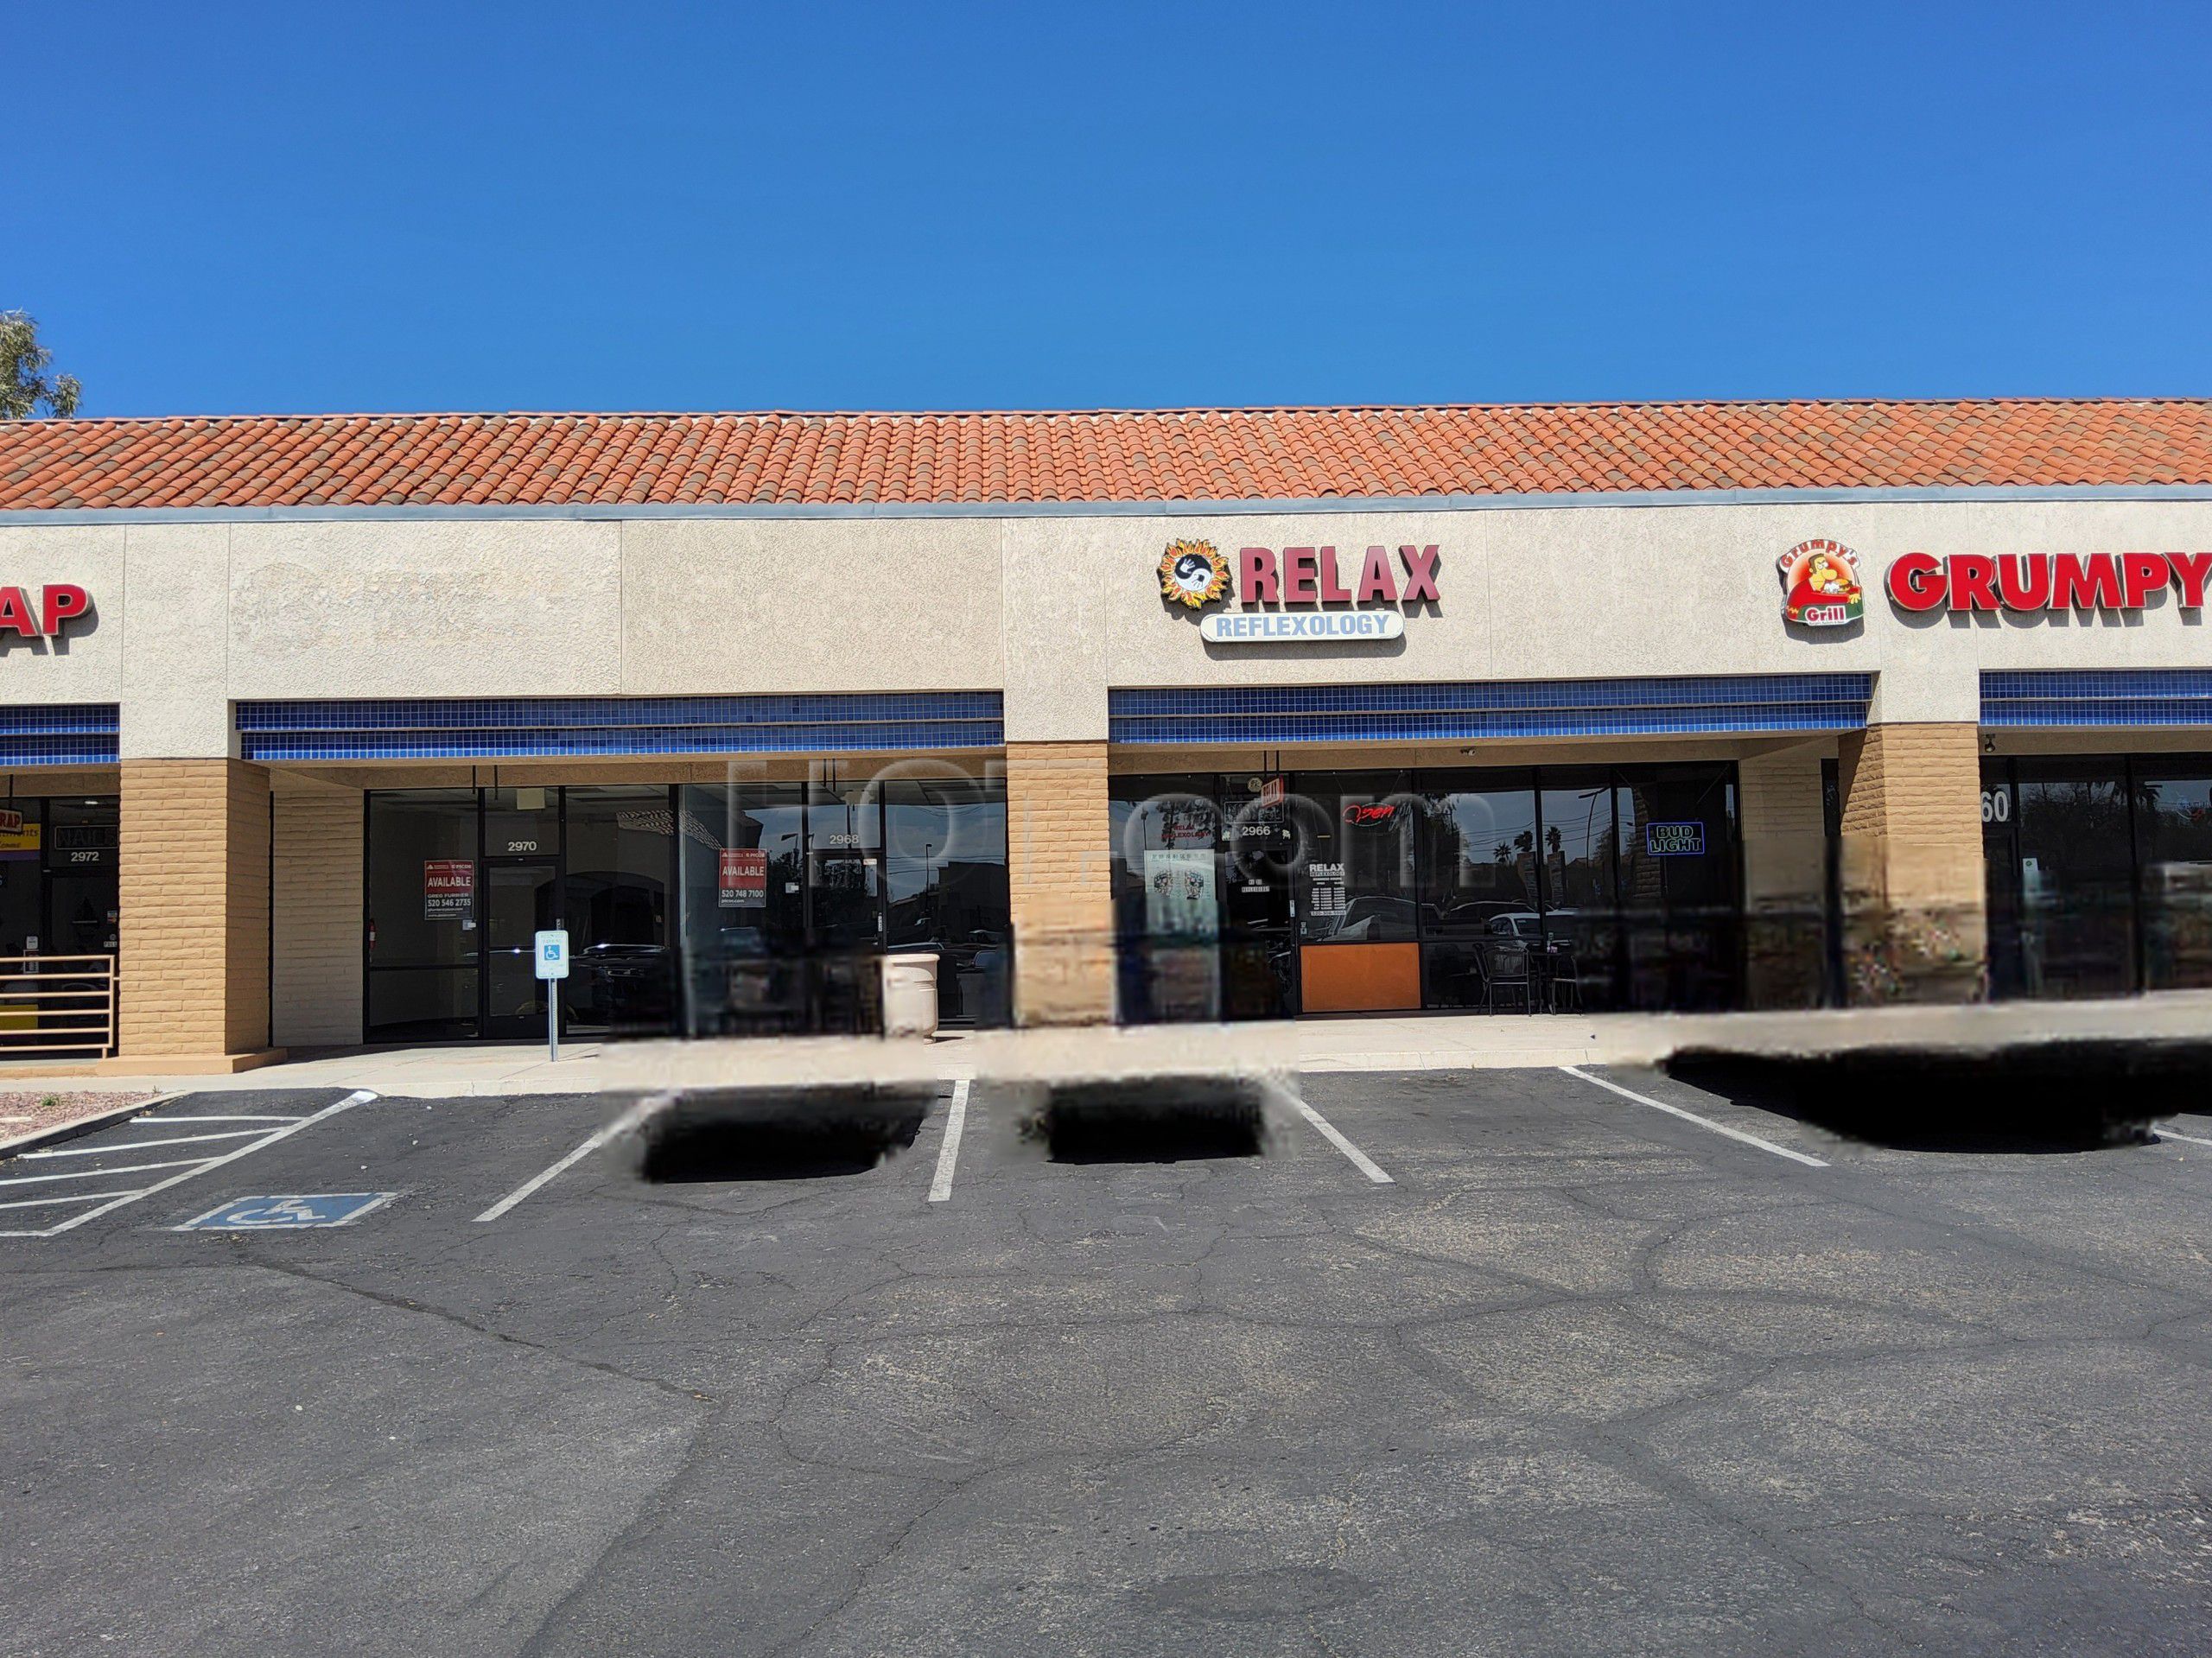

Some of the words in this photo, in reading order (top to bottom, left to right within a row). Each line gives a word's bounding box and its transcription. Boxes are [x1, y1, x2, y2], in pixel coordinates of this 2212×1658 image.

[1780, 539, 1858, 568] Grumpy's
[1240, 545, 1440, 603] RELAX
[1887, 551, 2212, 611] GRUMPY
[1806, 607, 1845, 621] Grill
[1216, 614, 1389, 637] REFLEXOLOGY
[1243, 826, 1271, 836] 2966
[1656, 825, 1694, 838] BUD
[830, 835, 859, 844] 2968
[1649, 837, 1701, 853] LIGHT
[508, 842, 537, 851] 2970
[71, 851, 99, 861] 2972
[722, 866, 764, 876] AVAILABLE
[1309, 863, 1344, 872] RELAX
[428, 876, 471, 887] AVAILABLE
